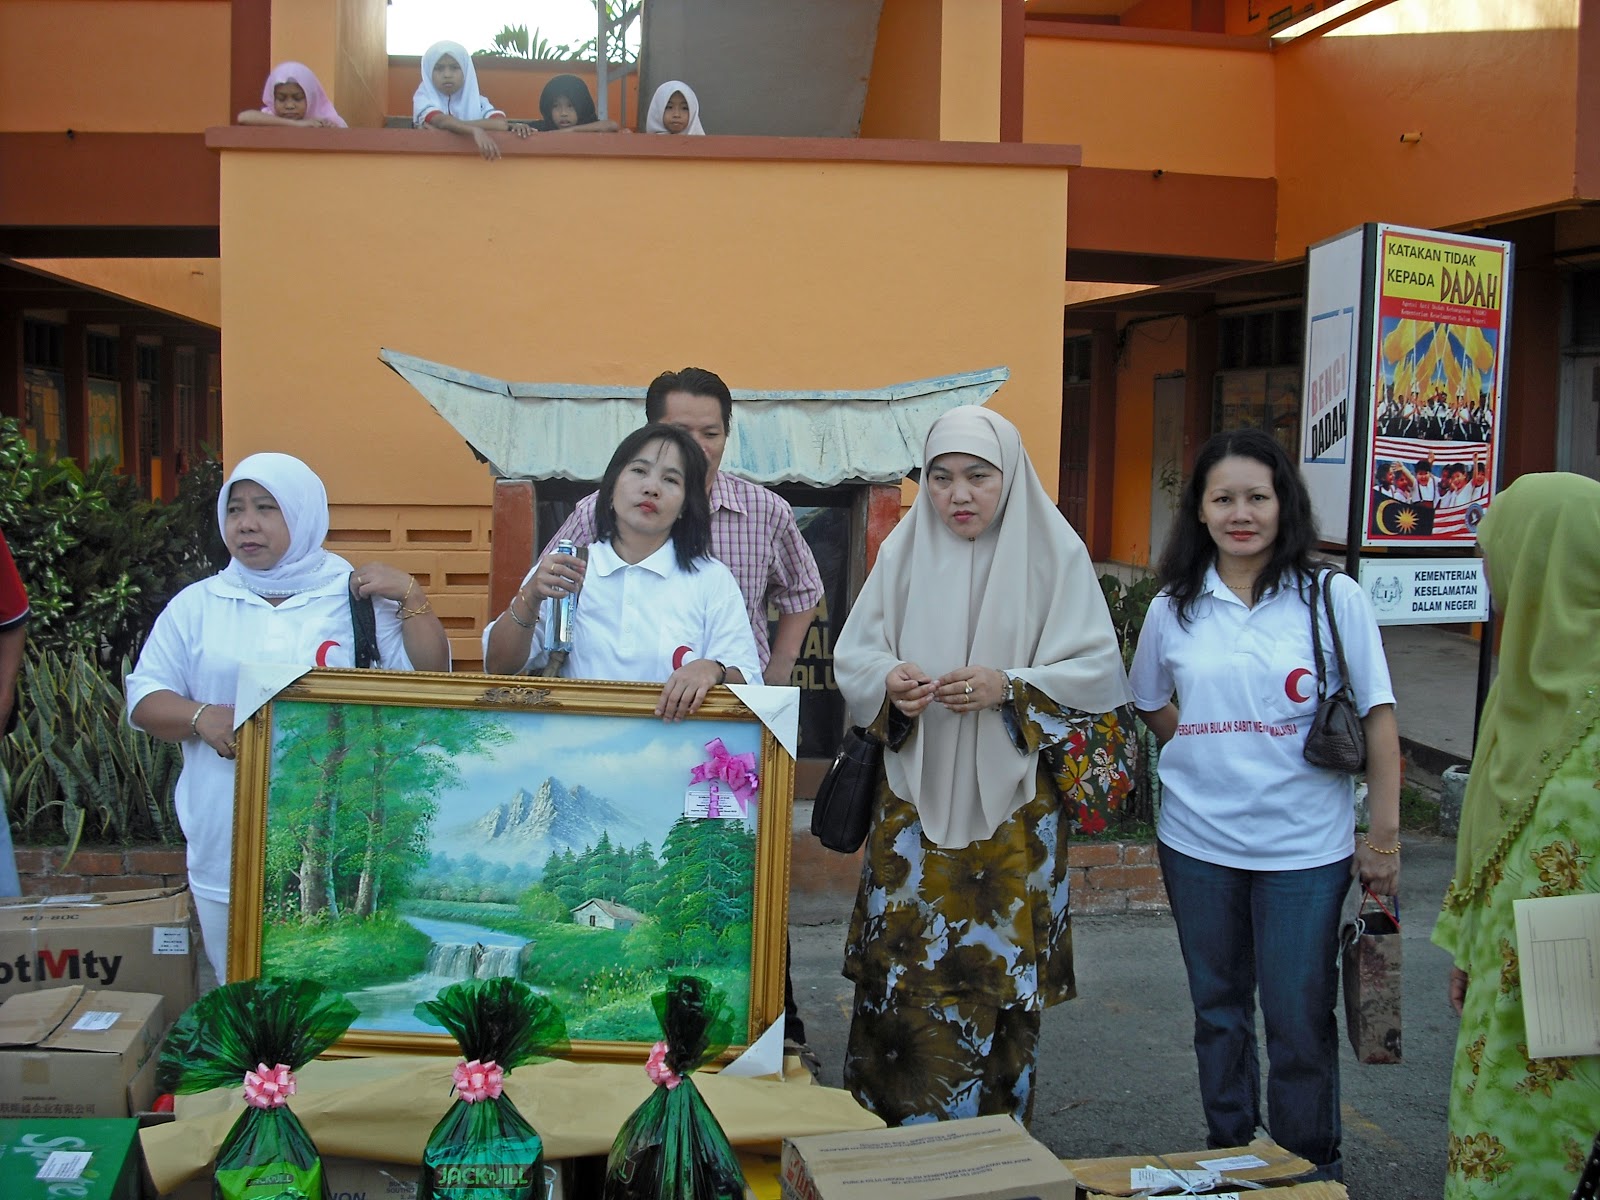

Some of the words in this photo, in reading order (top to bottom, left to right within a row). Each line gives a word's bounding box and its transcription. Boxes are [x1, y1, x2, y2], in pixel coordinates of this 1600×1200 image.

[1388, 243, 1441, 262] KATAKAN
[1444, 251, 1477, 267] TIDAK
[1387, 268, 1435, 287] KEPADA
[1440, 266, 1498, 309] DADAH
[1312, 352, 1346, 418] BENCI
[1311, 398, 1347, 462] DADAH
[1414, 570, 1477, 581] KEMENTERIAN
[1414, 585, 1477, 597] KESELAMATAN
[1412, 602, 1442, 612] DALAM
[1444, 600, 1476, 611] NEGERI
[1177, 723, 1209, 736] ERSATUAN
[1210, 721, 1232, 734] BULAN
[1233, 720, 1252, 732] SABIT
